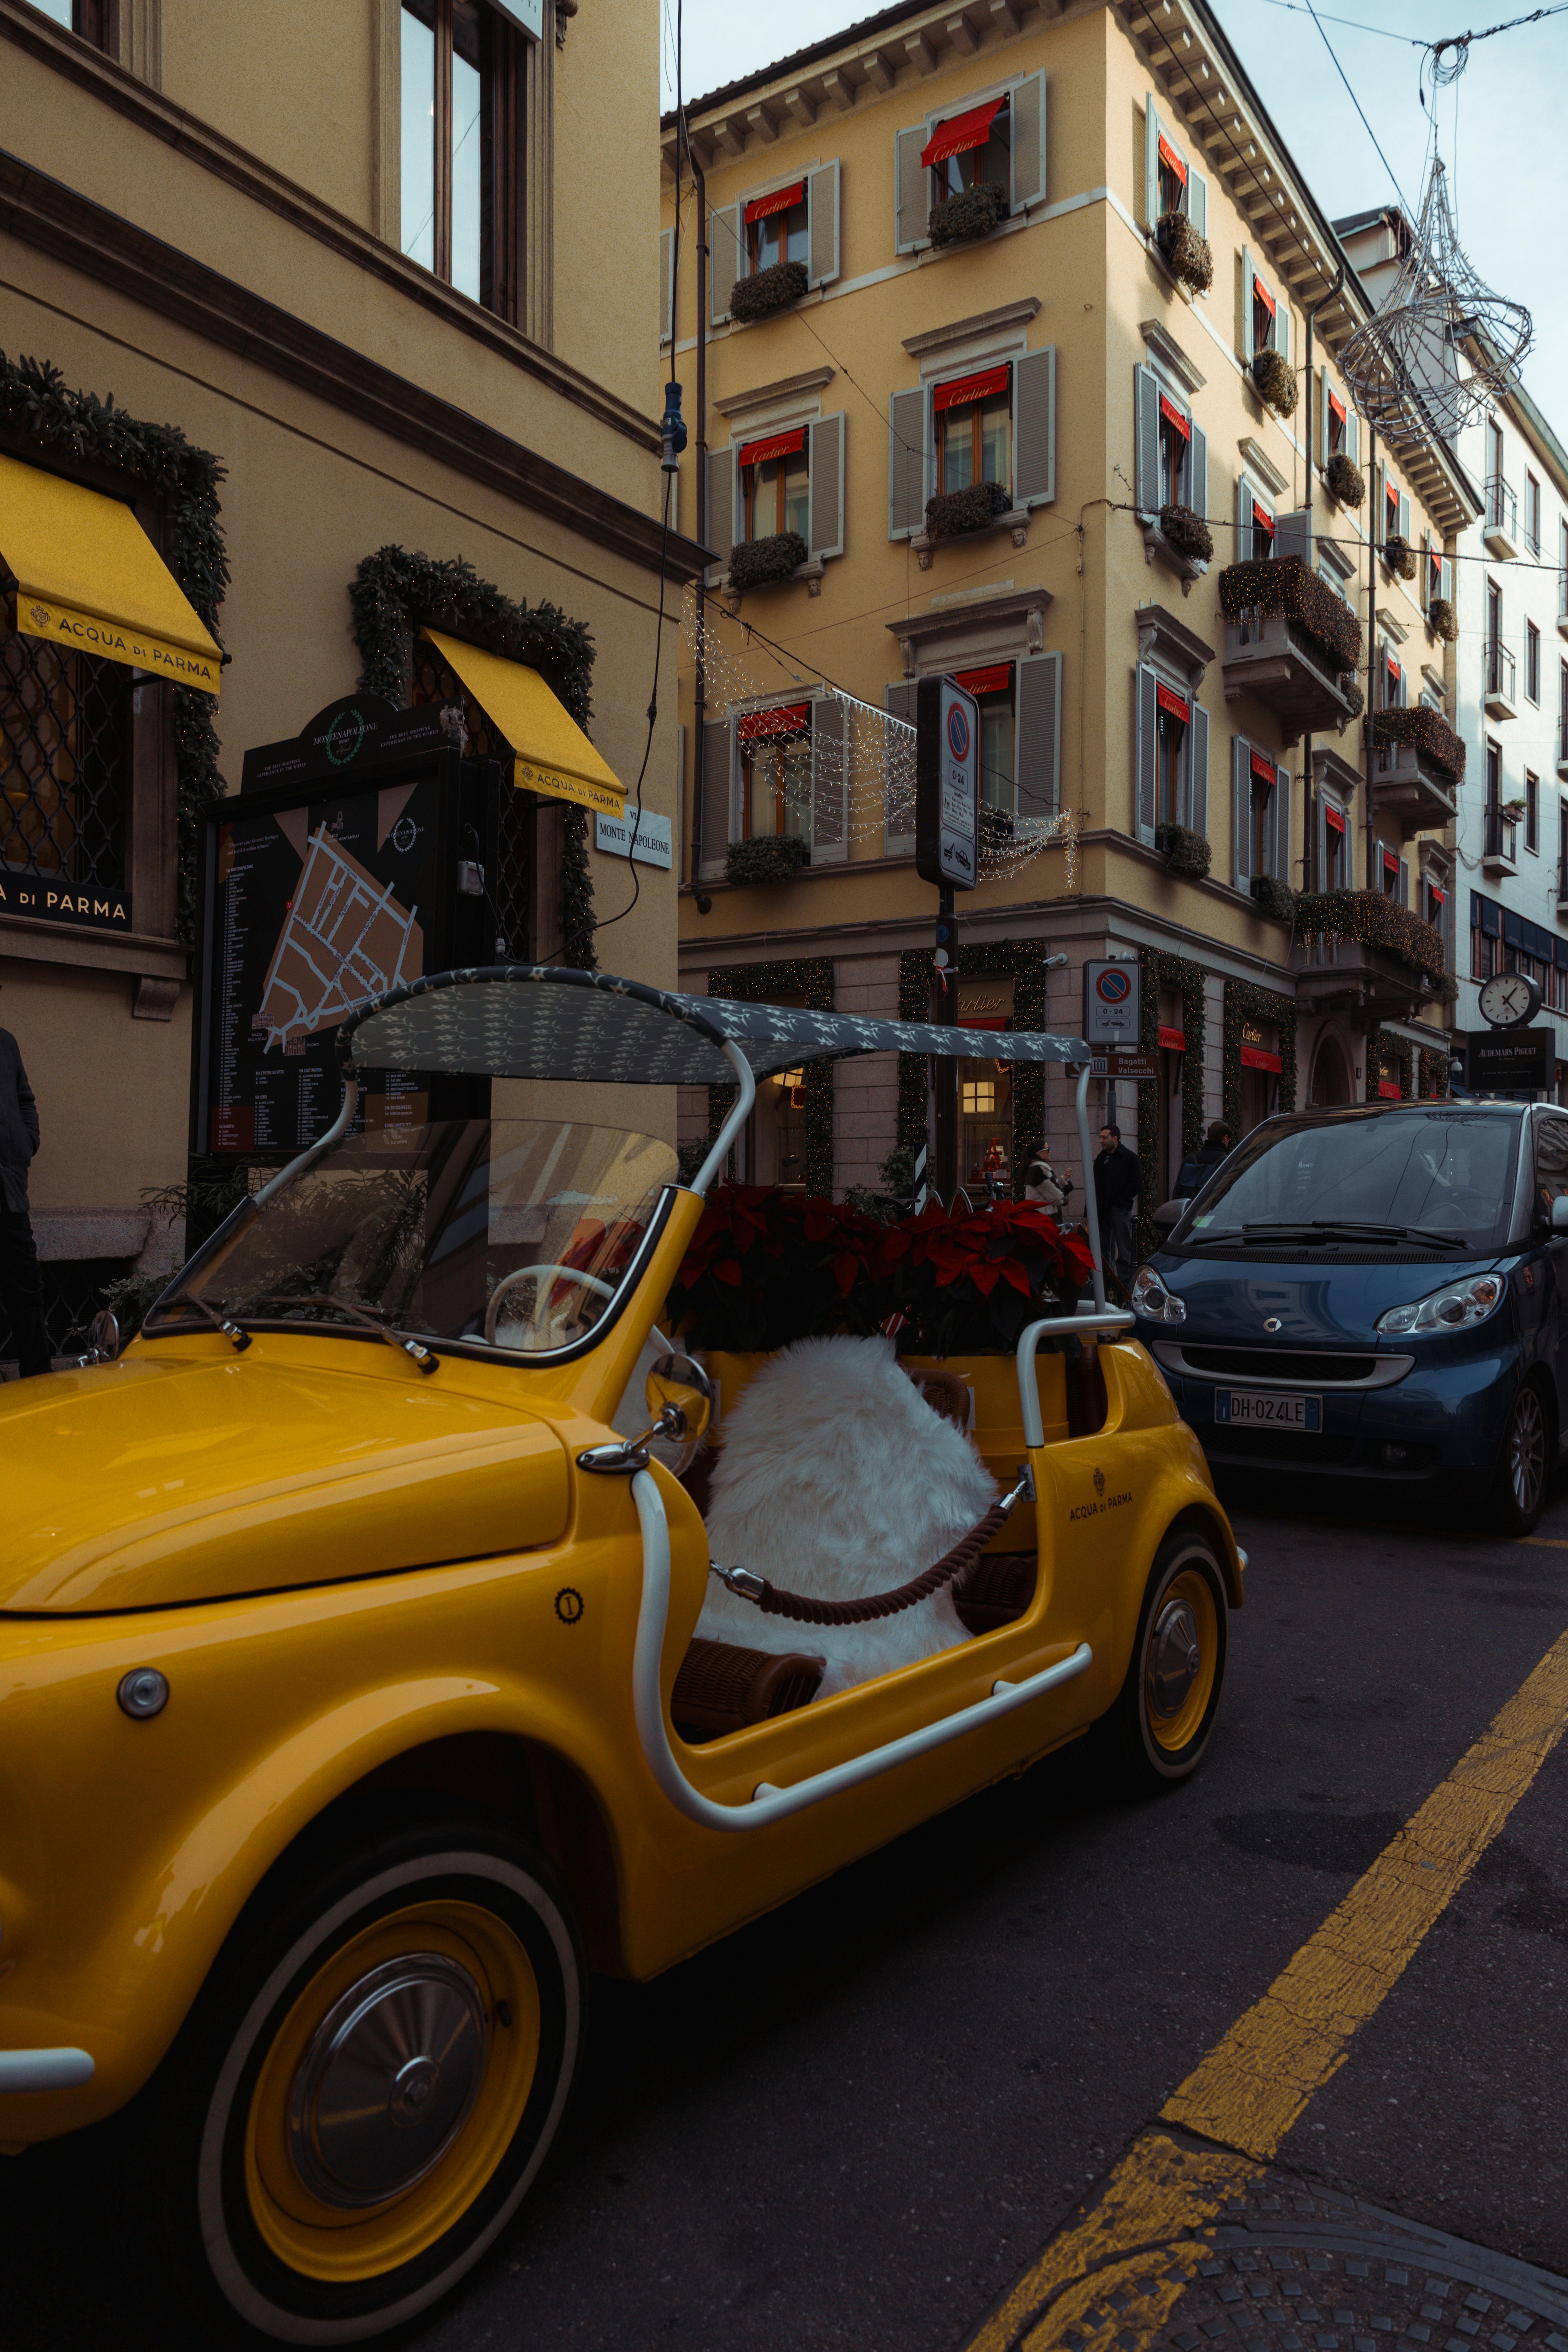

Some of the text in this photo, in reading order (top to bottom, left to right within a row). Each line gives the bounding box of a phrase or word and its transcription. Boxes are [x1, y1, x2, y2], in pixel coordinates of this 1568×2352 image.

[933, 139, 977, 163] Cartier
[1164, 147, 1182, 177] Cartier
[755, 199, 791, 219] Cartier
[949, 387, 992, 406] Cartier
[1167, 406, 1185, 432] Cartier
[752, 446, 790, 462] Cartier
[59, 619, 127, 651] ACQUA
[153, 649, 211, 680] PARMA
[967, 684, 991, 694] rtier
[1165, 698, 1182, 717] Cartier
[409, 726, 431, 735] SHOPPING
[380, 737, 406, 747] EXPERIENCE
[282, 758, 300, 767] SHOPPING
[1257, 763, 1270, 779] Cartier
[257, 769, 279, 778] EXPERIENCE
[538, 774, 574, 793] ACQUA
[588, 790, 620, 810] PARMA
[630, 811, 640, 821] VI
[600, 823, 669, 854] MONTE NAPOLEONE
[20, 891, 126, 920] DI PARMA
[958, 993, 1004, 1011] artier
[1162, 1032, 1178, 1047] Cartier
[1243, 1023, 1262, 1042] Cartier
[1479, 1047, 1537, 1057] AUDEMARS PIGUET
[1118, 1058, 1147, 1066] Bagatti
[1255, 1400, 1304, 1422] 024LE
[1070, 1502, 1098, 1522] ACQUA
[1108, 1491, 1133, 1509] PARMA
